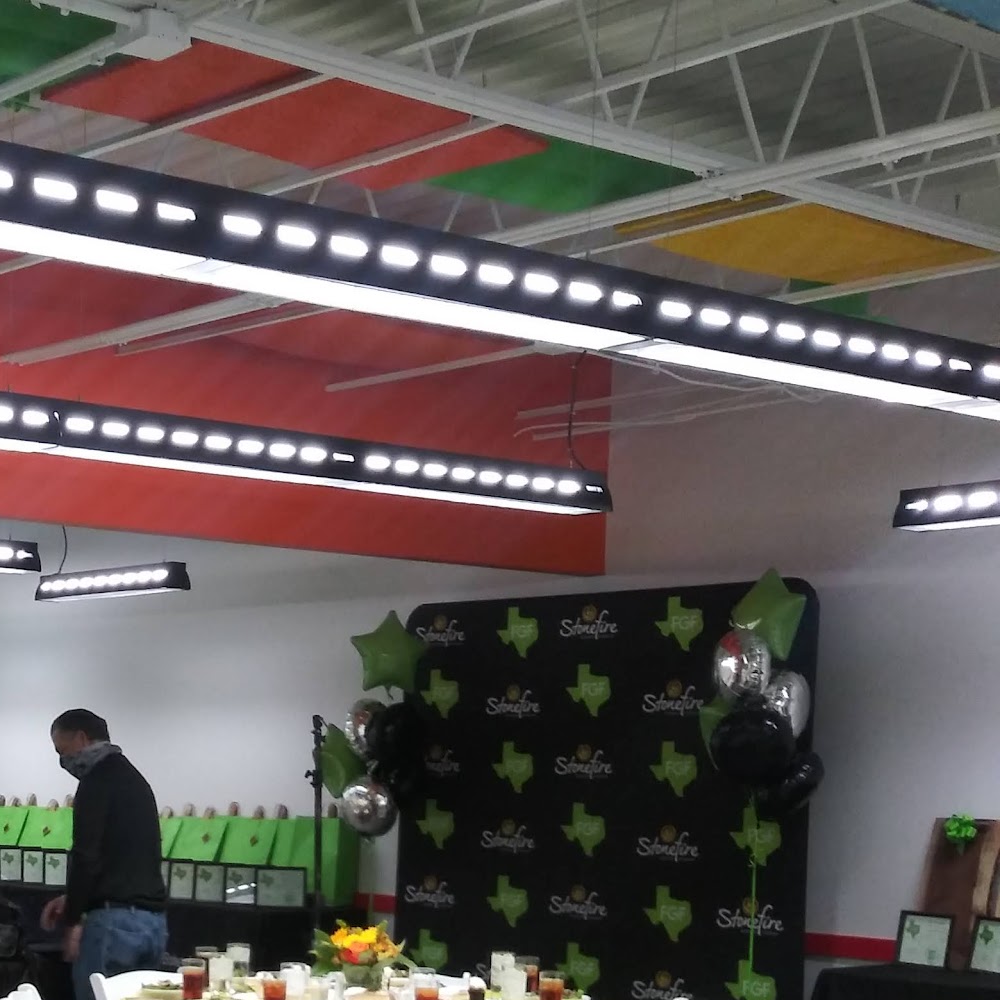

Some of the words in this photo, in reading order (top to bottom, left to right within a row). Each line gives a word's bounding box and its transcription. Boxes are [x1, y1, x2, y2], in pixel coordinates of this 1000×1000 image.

[416, 619, 466, 646] Stonefire
[559, 610, 619, 640] Stonefire
[671, 615, 698, 631] FGF
[485, 689, 541, 718] Stonefire
[642, 686, 704, 716] Stonefire
[555, 750, 613, 779] Stonefire
[480, 825, 535, 854] Stonefire
[637, 832, 699, 862] Stonefire
[404, 881, 456, 909] Stonefire
[549, 892, 608, 920] Stonefire
[717, 905, 784, 936] Stonefire
